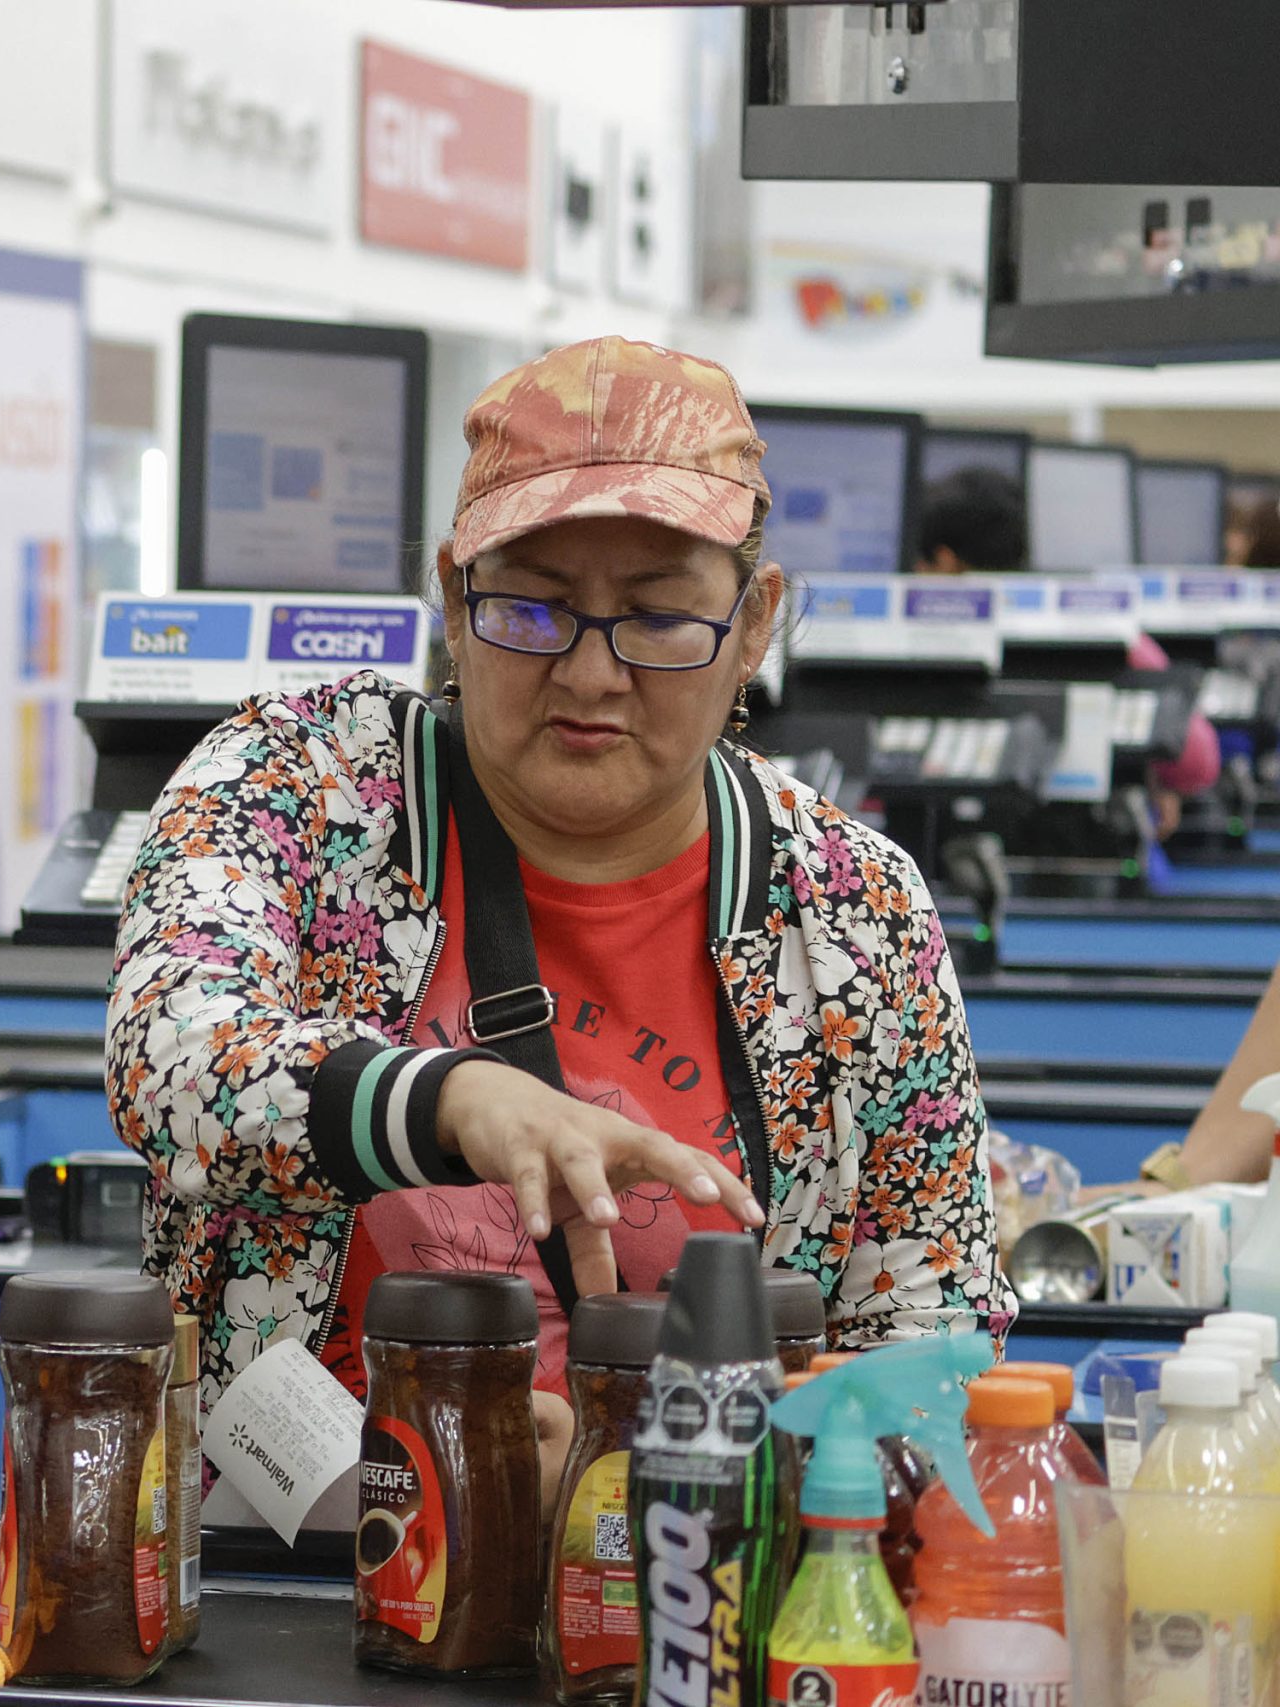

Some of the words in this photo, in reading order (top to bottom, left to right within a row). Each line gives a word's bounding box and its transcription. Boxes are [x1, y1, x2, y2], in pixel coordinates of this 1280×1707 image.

[365, 93, 460, 201] BIC
[131, 625, 188, 656] bait
[626, 1025, 701, 1092] TO
[246, 1438, 295, 1497] Walmart
[801, 1676, 820, 1700] 2
[924, 1674, 1069, 1707] GATORLYTE
